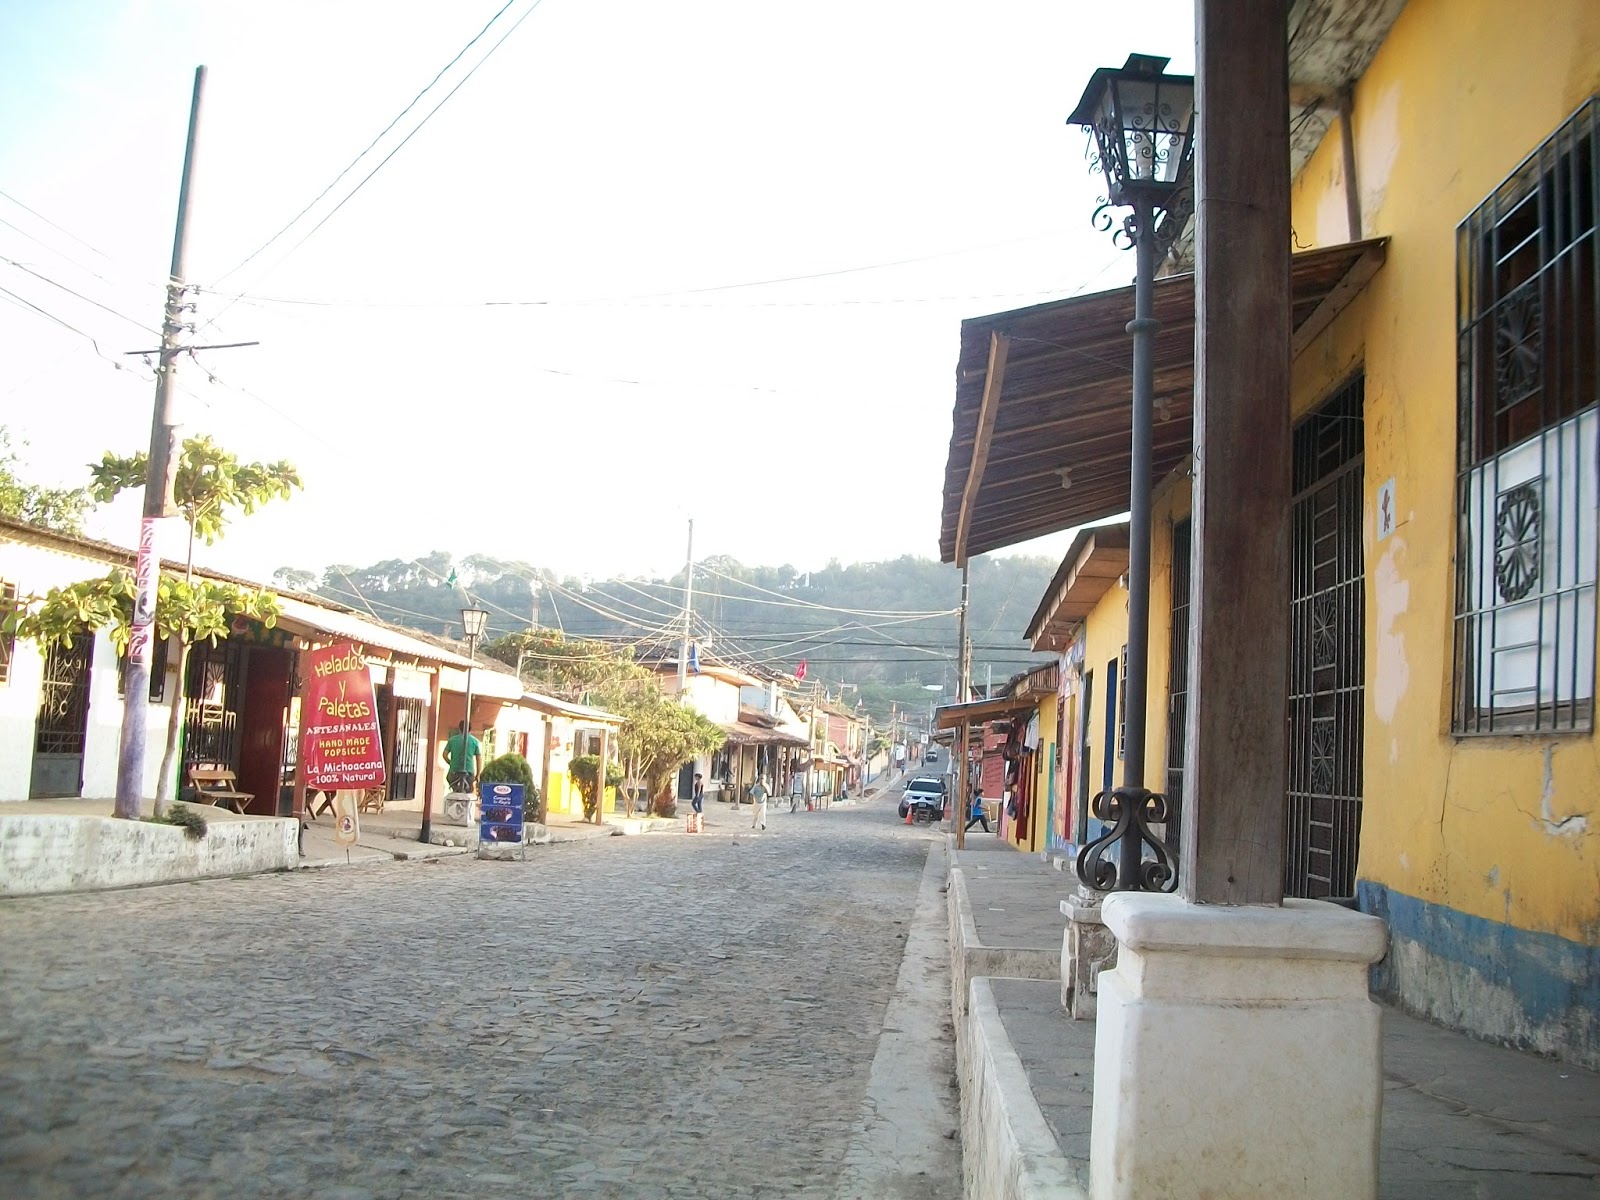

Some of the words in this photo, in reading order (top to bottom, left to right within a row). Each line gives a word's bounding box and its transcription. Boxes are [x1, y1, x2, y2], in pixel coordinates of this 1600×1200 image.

[314, 649, 365, 677] Helados
[318, 697, 370, 718] Paletas
[306, 722, 377, 735] ARTESANALES
[319, 739, 343, 748] HAND
[346, 737, 370, 745] MADE
[324, 747, 366, 757] POPSICLE
[307, 764, 320, 775] La
[324, 761, 383, 773] Michoacana
[316, 774, 339, 784] 100%
[342, 771, 376, 782] Natural
